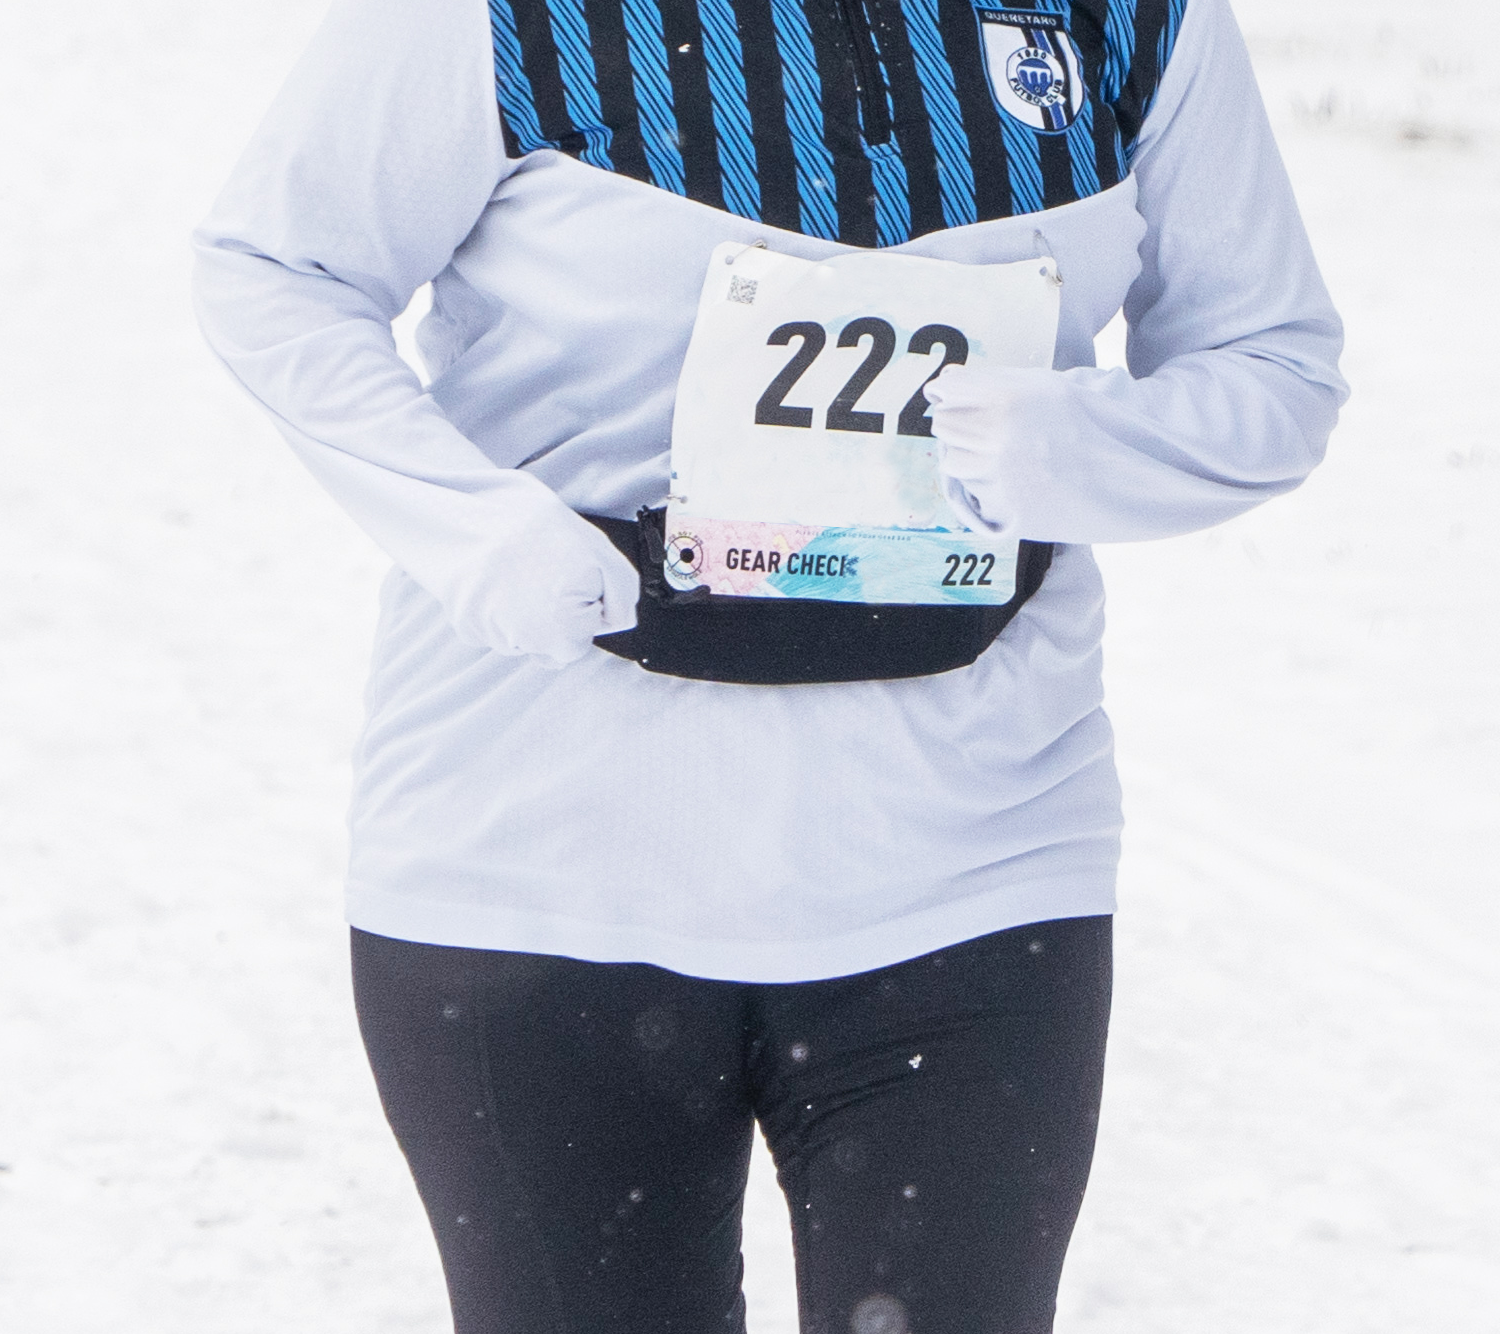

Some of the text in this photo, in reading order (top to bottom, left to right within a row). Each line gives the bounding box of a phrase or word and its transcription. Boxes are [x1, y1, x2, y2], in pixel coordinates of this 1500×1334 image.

[754, 317, 969, 438] 222
[726, 548, 781, 575] GEAR
[786, 552, 859, 577] CHECK
[941, 554, 995, 587] 222
